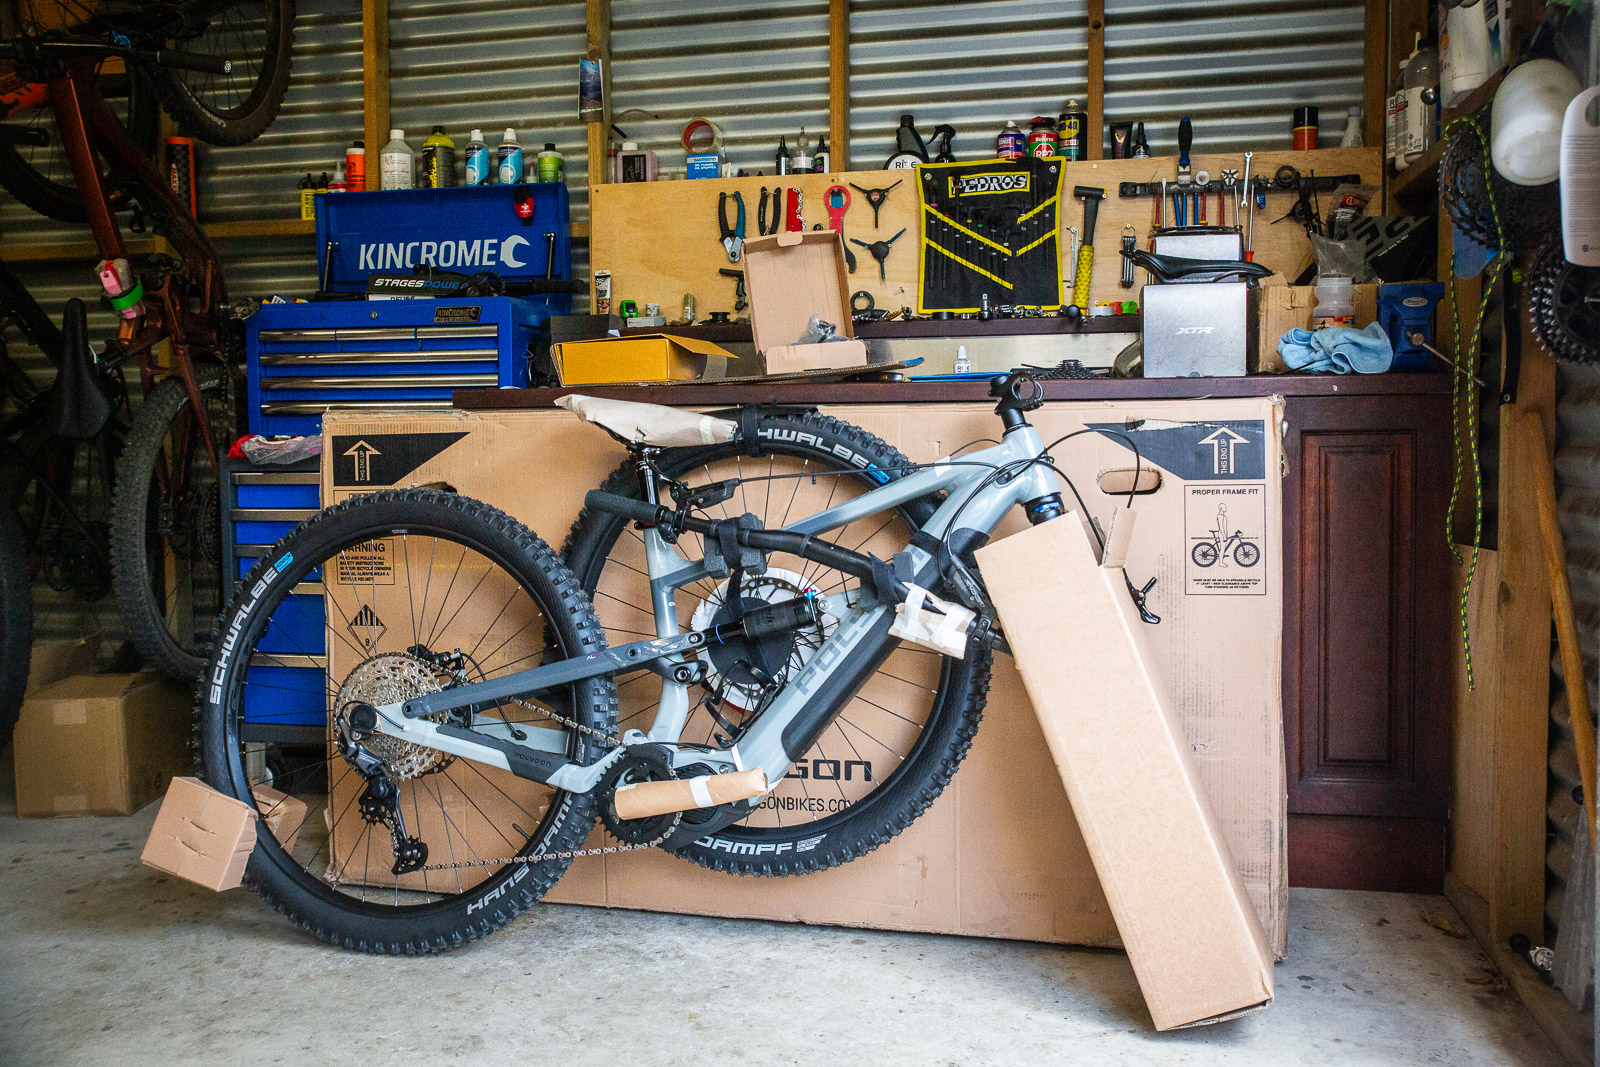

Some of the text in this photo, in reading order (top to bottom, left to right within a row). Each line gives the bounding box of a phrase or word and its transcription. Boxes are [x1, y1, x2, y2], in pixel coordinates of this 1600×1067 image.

[358, 239, 499, 270] KINCROME
[1175, 326, 1214, 335] XTR
[757, 428, 870, 469] HWALBE
[348, 543, 386, 552] ARNING
[209, 567, 278, 705] SCHWALBE
[513, 752, 551, 767] POLYGON
[467, 865, 530, 915] HANS
